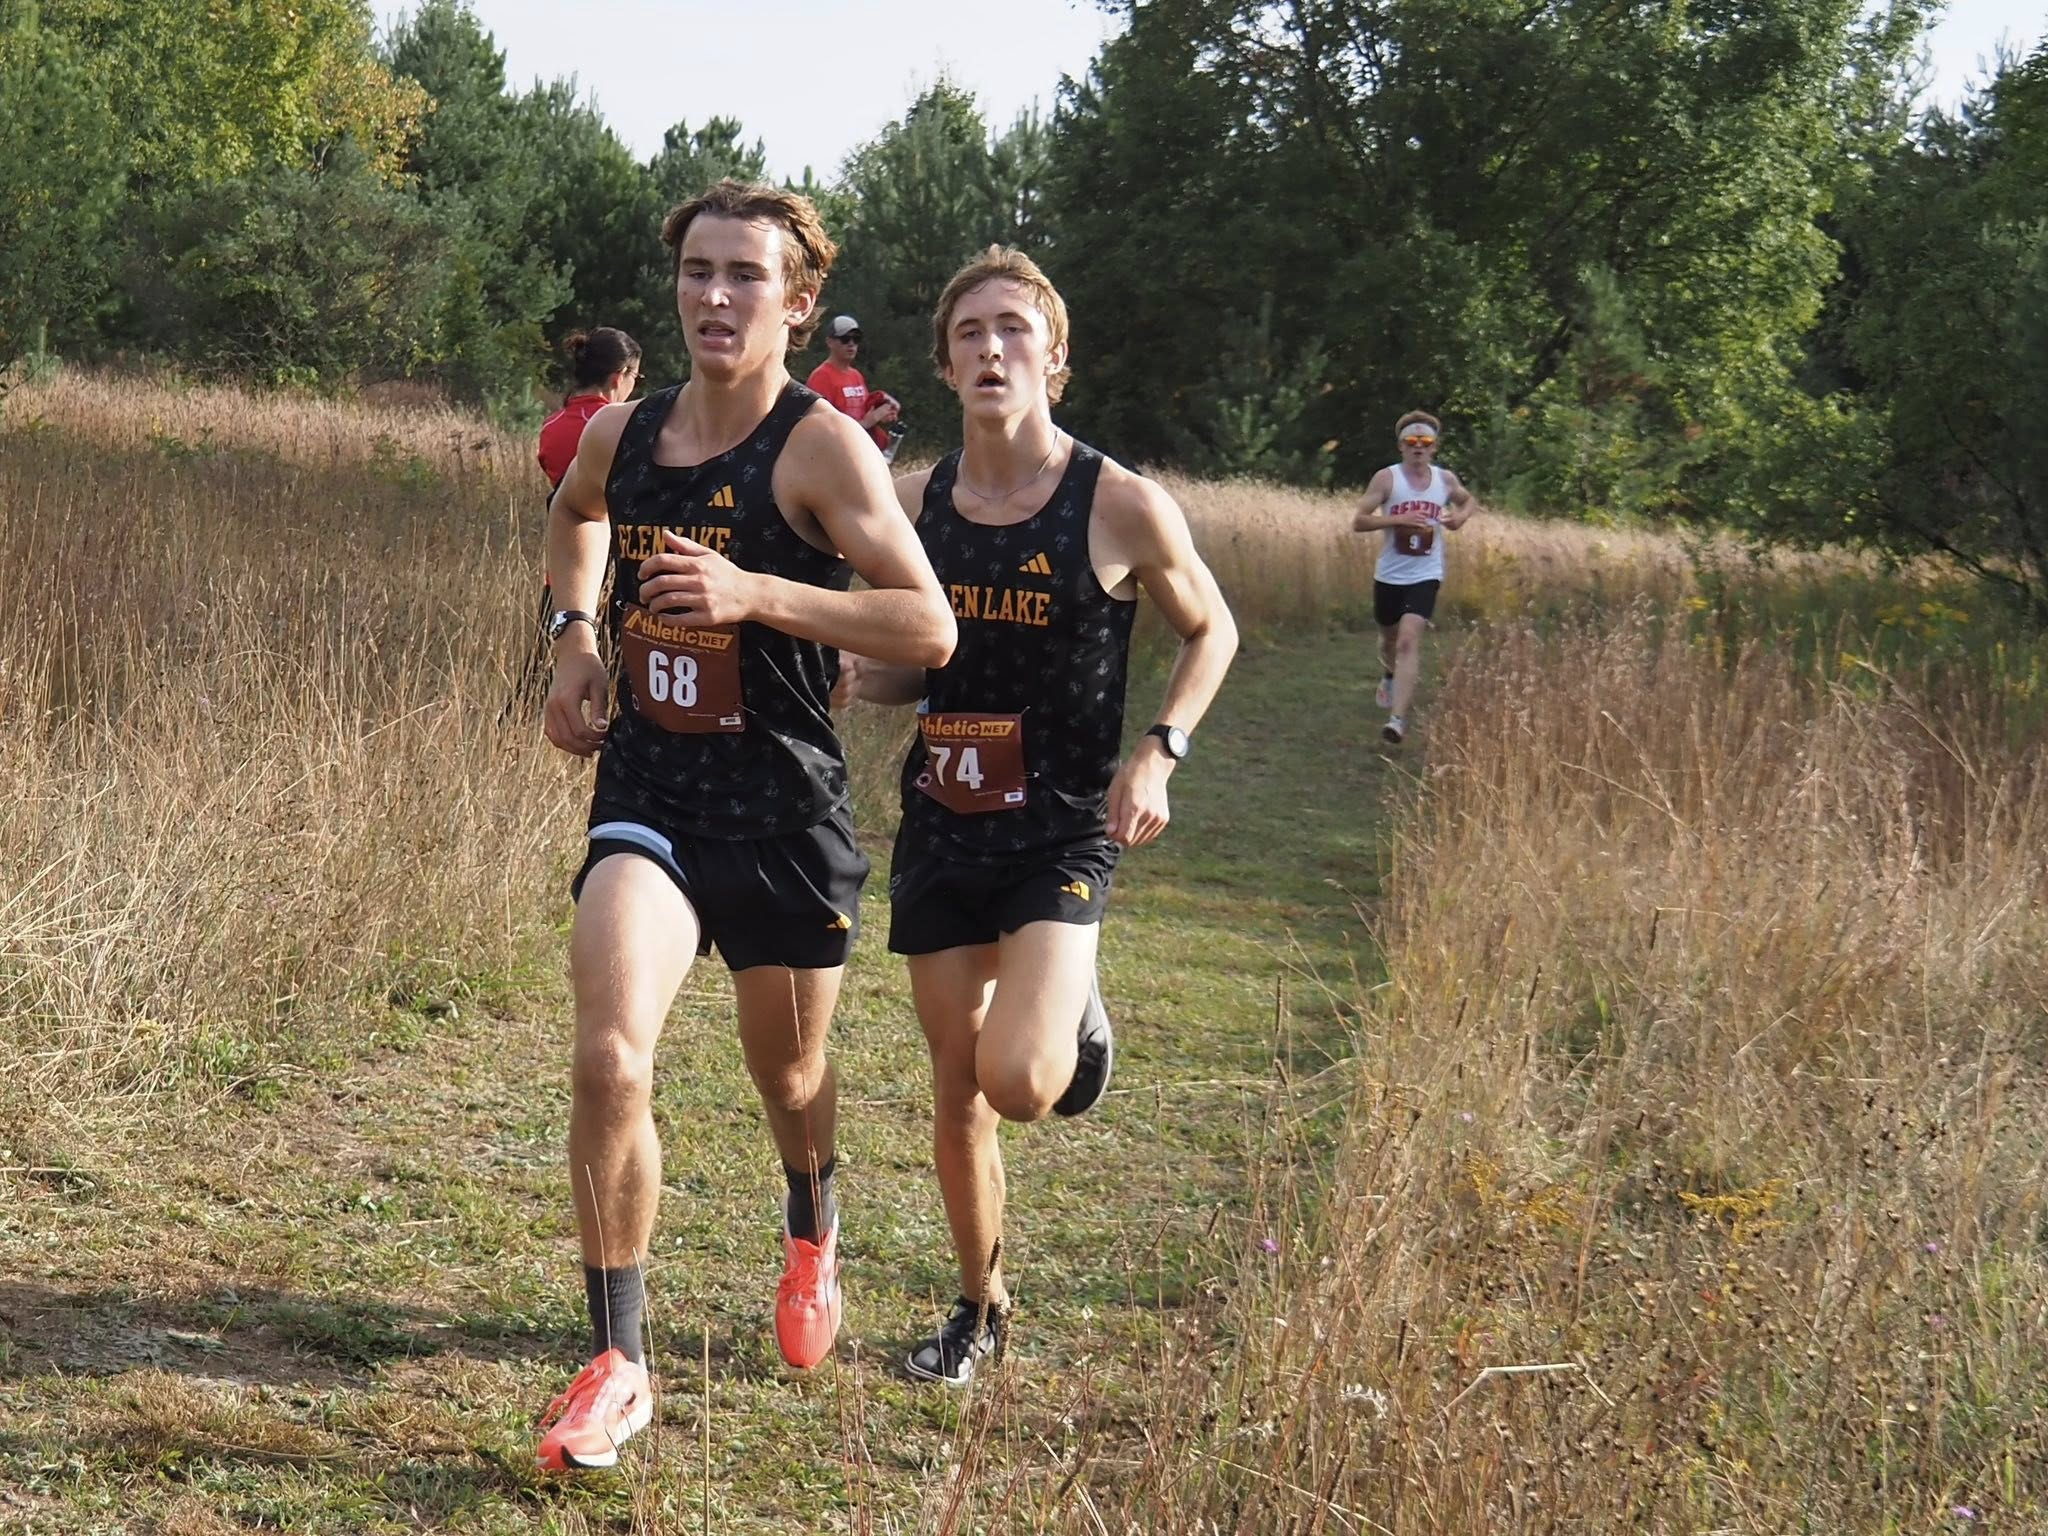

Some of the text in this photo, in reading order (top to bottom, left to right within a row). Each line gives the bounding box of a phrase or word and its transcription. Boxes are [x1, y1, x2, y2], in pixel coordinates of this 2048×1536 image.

[983, 587, 1050, 626] LAKE
[648, 650, 698, 708] 68
[929, 745, 984, 790] 74
